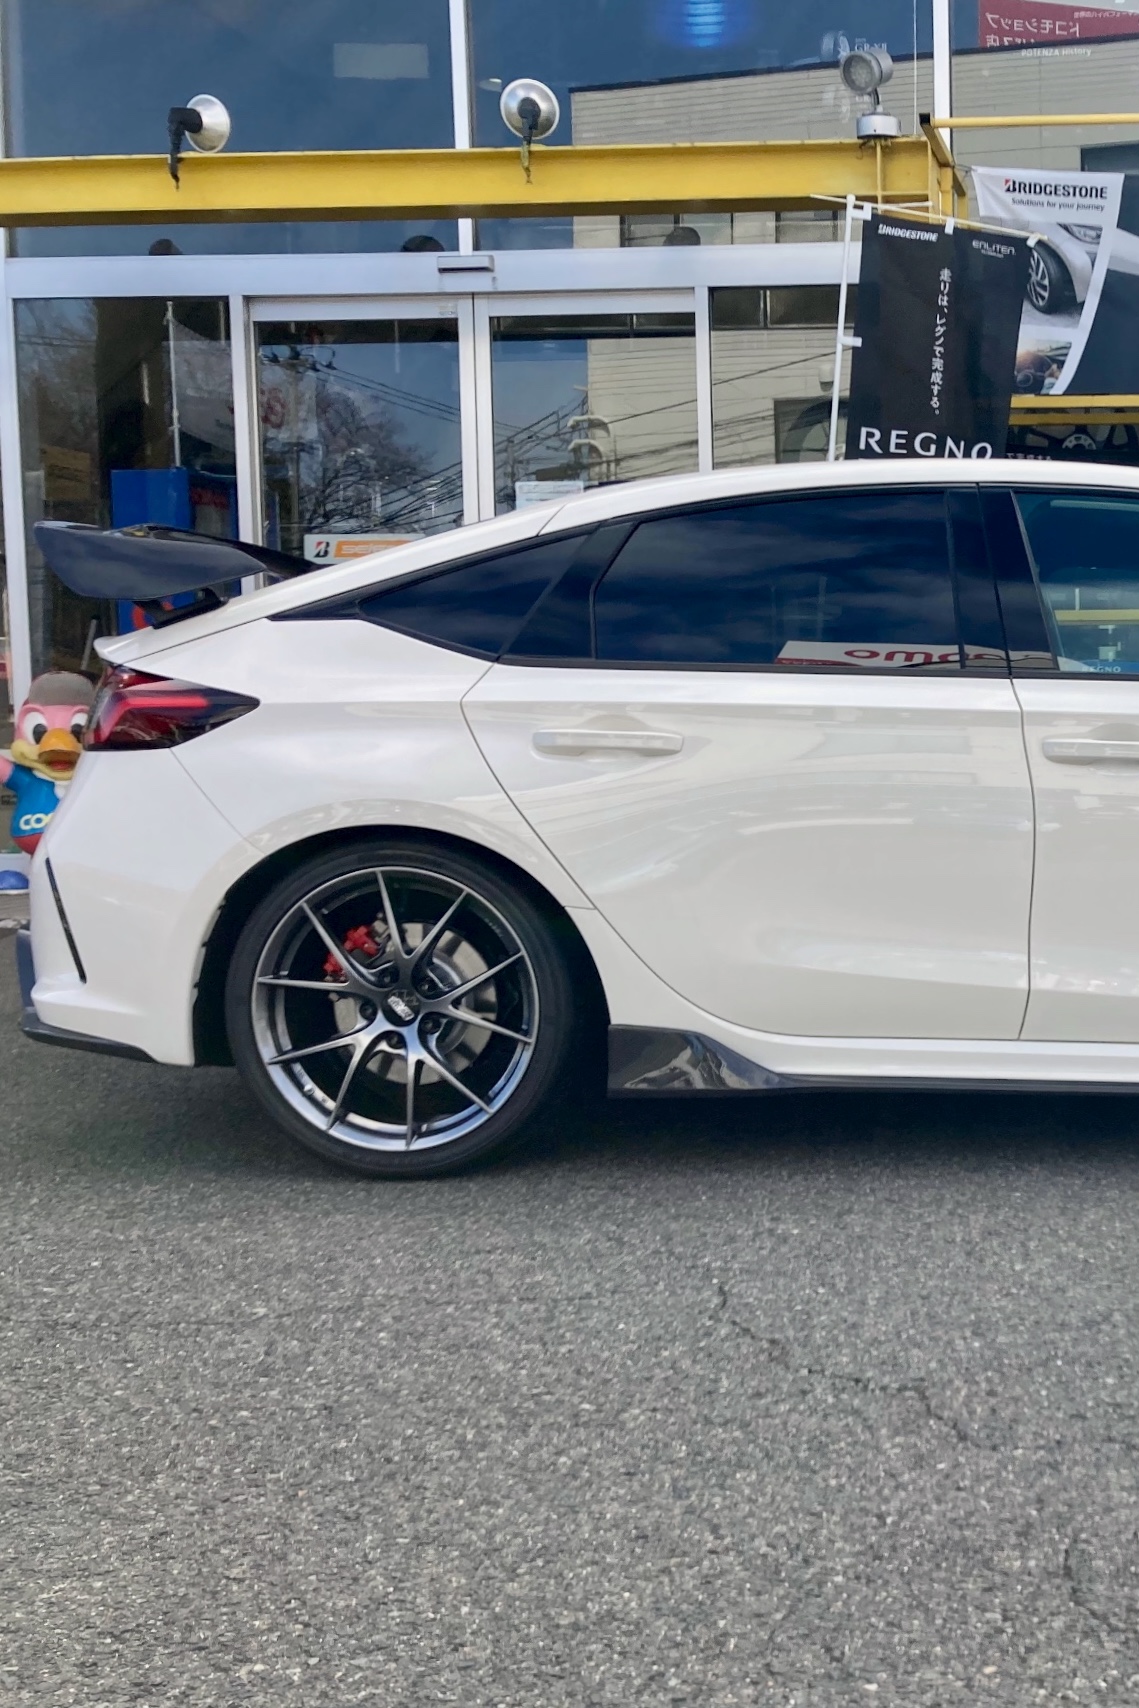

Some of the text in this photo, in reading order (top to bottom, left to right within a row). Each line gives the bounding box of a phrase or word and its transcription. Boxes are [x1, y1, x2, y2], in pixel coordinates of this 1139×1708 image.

[1004, 178, 1108, 199] BRIDGESTONE
[1012, 197, 1106, 212] Solutions for your journey
[878, 223, 939, 242] BRIDGESTONE
[859, 426, 993, 460] REGNO
